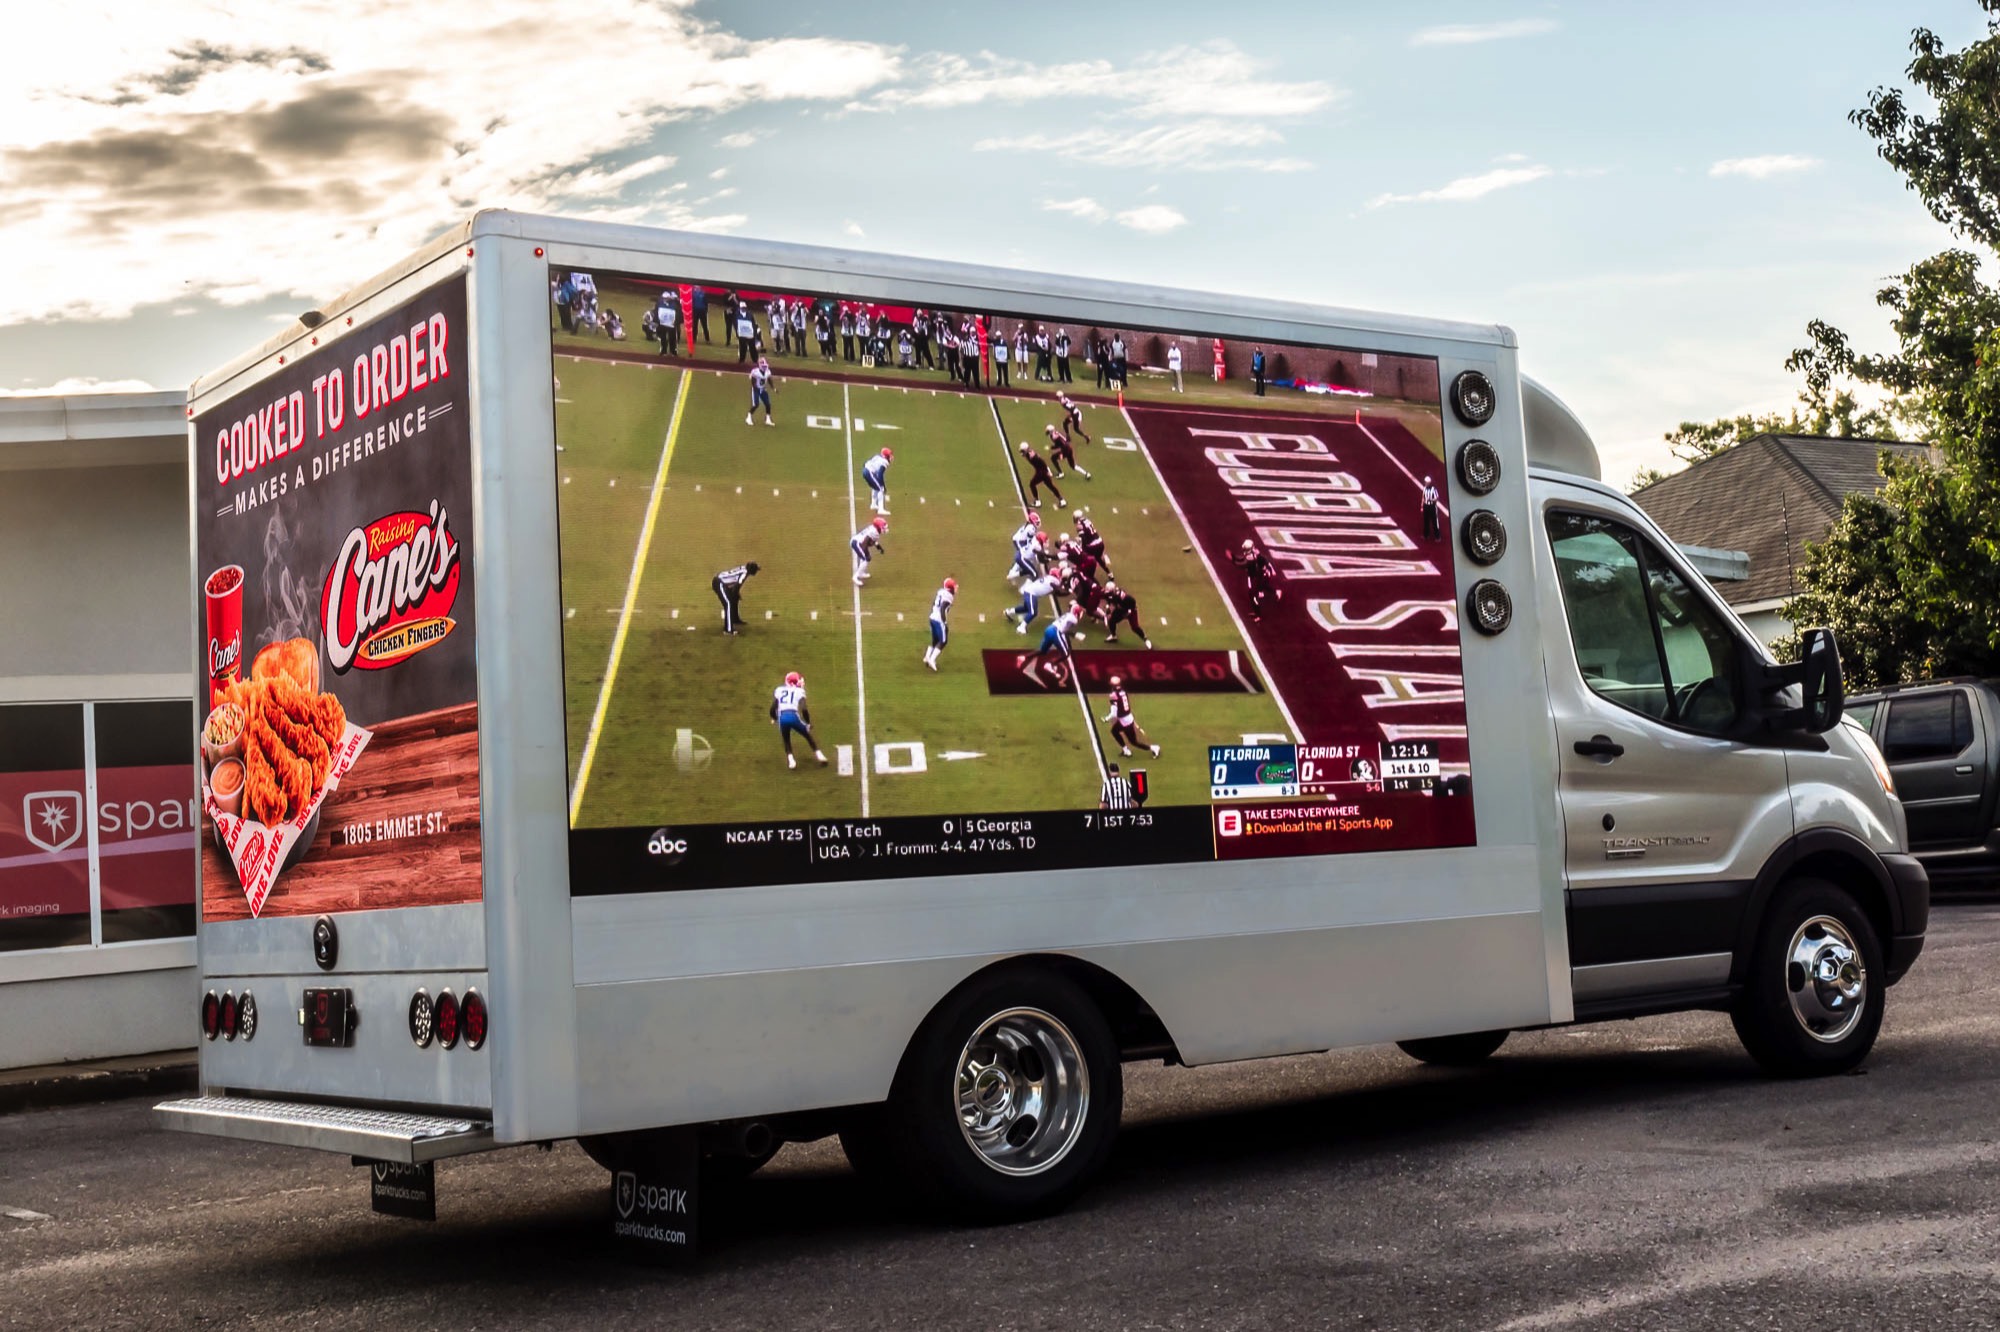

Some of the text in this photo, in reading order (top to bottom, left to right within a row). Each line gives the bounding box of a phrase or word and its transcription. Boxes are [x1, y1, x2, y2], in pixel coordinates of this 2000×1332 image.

[217, 312, 448, 486] COOKED TO ORDER
[235, 406, 427, 516] MAKES A DIFFERENCE
[1187, 427, 1442, 580] FLORIDA
[369, 516, 415, 556] Raising
[326, 498, 460, 669] Cane's
[368, 621, 446, 657] CHICKEN FINGERS
[209, 629, 240, 678] Cane's
[1181, 663, 1226, 681] 10
[779, 690, 795, 704] 21
[837, 742, 927, 776] 10
[1224, 748, 1270, 761] FLORIDA
[1299, 746, 1360, 759] FLORIDA ST
[1391, 744, 1428, 758] 12:14
[1214, 764, 1227, 784] 0
[1301, 761, 1314, 781] 0
[1391, 763, 1430, 775] 1st & 10
[1394, 780, 1408, 789] 1st
[1084, 815, 1092, 828] 7
[1104, 814, 1153, 827] 1ST 7:53
[1244, 805, 1360, 820] TAKE ESPN EVERYWHERE
[343, 811, 446, 845] 1805 EMMET ST.
[816, 823, 882, 839] GA Tech
[943, 820, 954, 834] 0
[966, 818, 1032, 834] 5 Georgia
[1254, 816, 1393, 834] Download the #1 Sports App
[648, 836, 687, 854] abc
[726, 828, 803, 844] NCAAF T25
[819, 845, 850, 859] UGA
[872, 843, 883, 857] J.
[886, 841, 938, 857] Fromm:
[969, 838, 985, 851] 47
[1018, 836, 1036, 850] TD
[251, 829, 284, 916] ONE LOVE
[13, 903, 60, 915] imaging
[374, 1183, 427, 1202] sparktrucks.com
[638, 1184, 687, 1215] spark
[615, 1220, 687, 1246] sparktrucks.com
